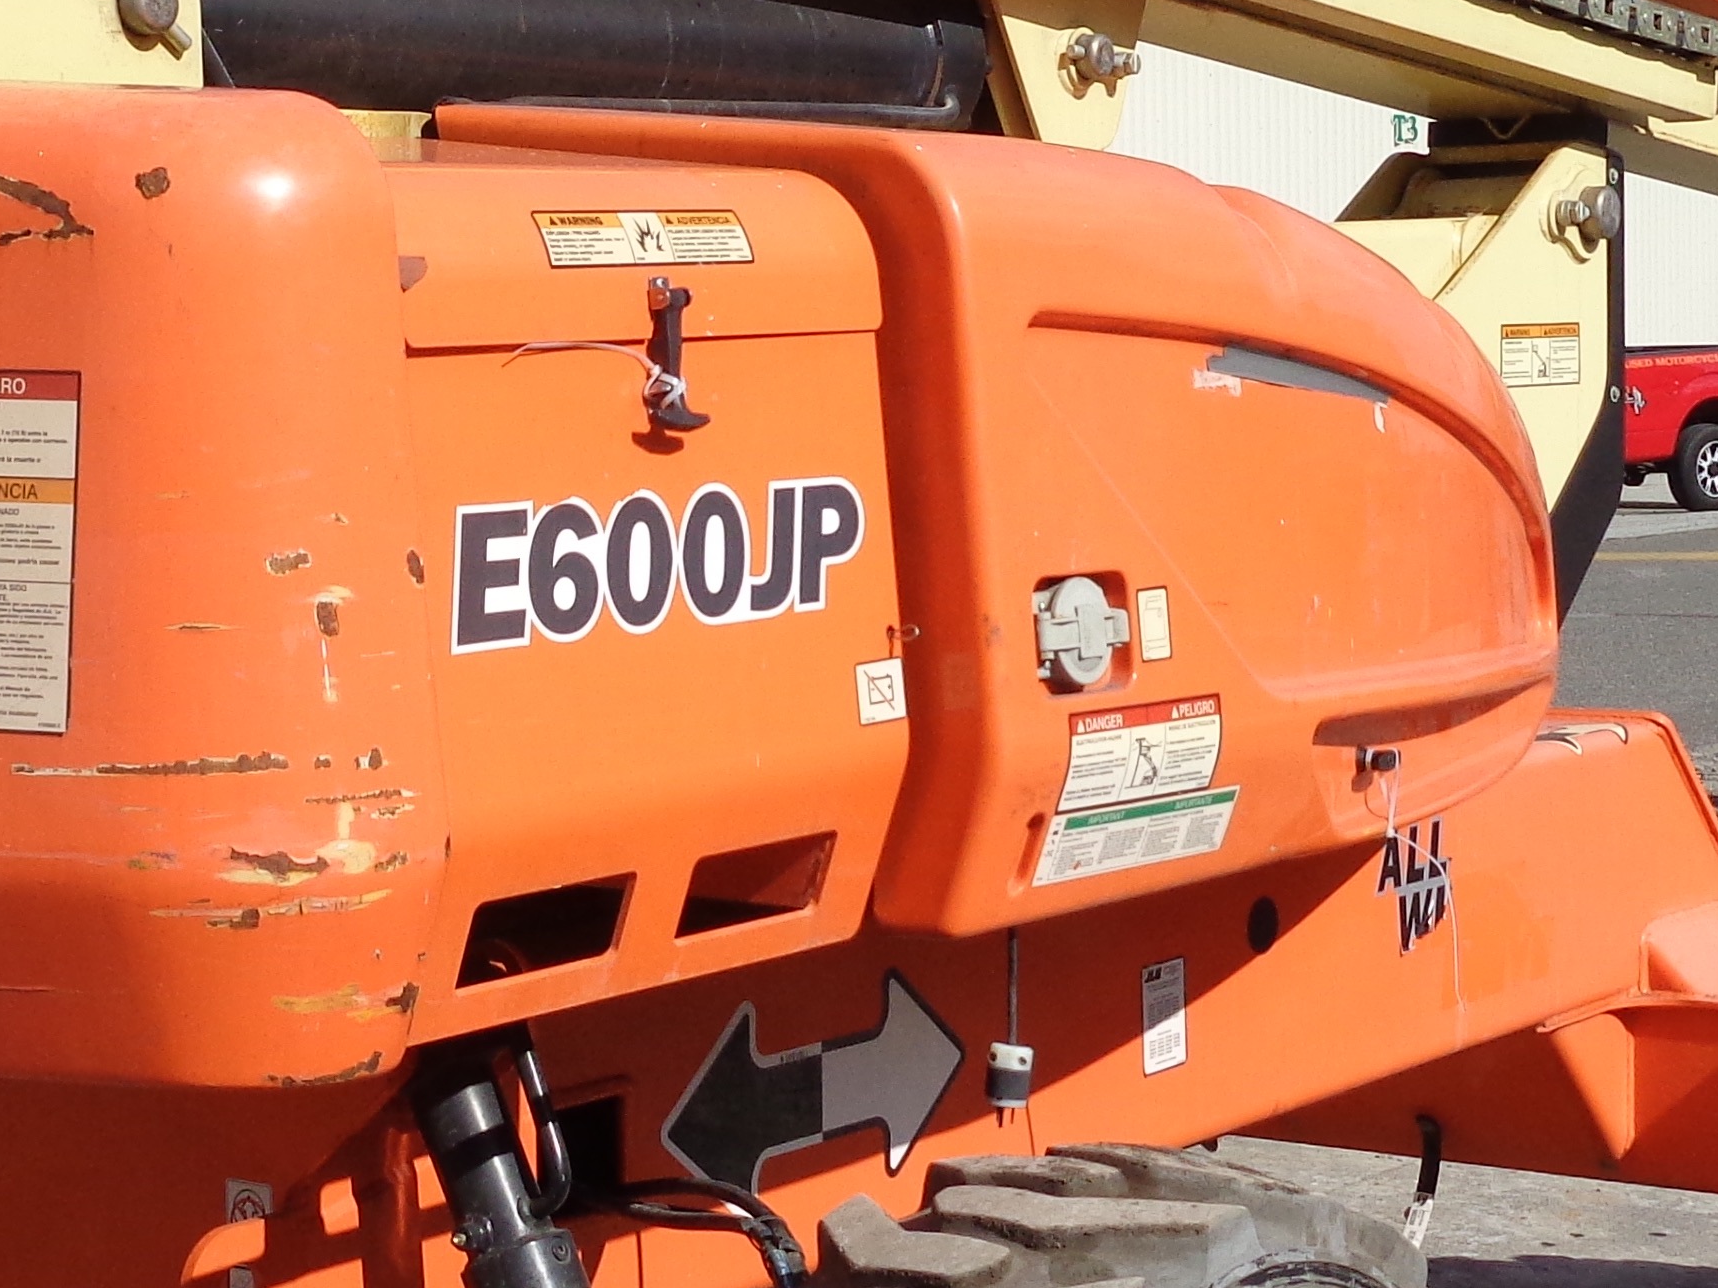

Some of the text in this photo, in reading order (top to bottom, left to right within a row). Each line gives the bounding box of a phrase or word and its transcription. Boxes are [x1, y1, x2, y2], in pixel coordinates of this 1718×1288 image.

[1392, 113, 1419, 147] T3
[558, 215, 604, 226] WARNING
[1625, 359, 1654, 369] USED
[453, 478, 863, 652] E600JP
[1178, 699, 1215, 718] PELIGRO
[1084, 713, 1123, 732] DANGER
[1377, 820, 1448, 893] ALL
